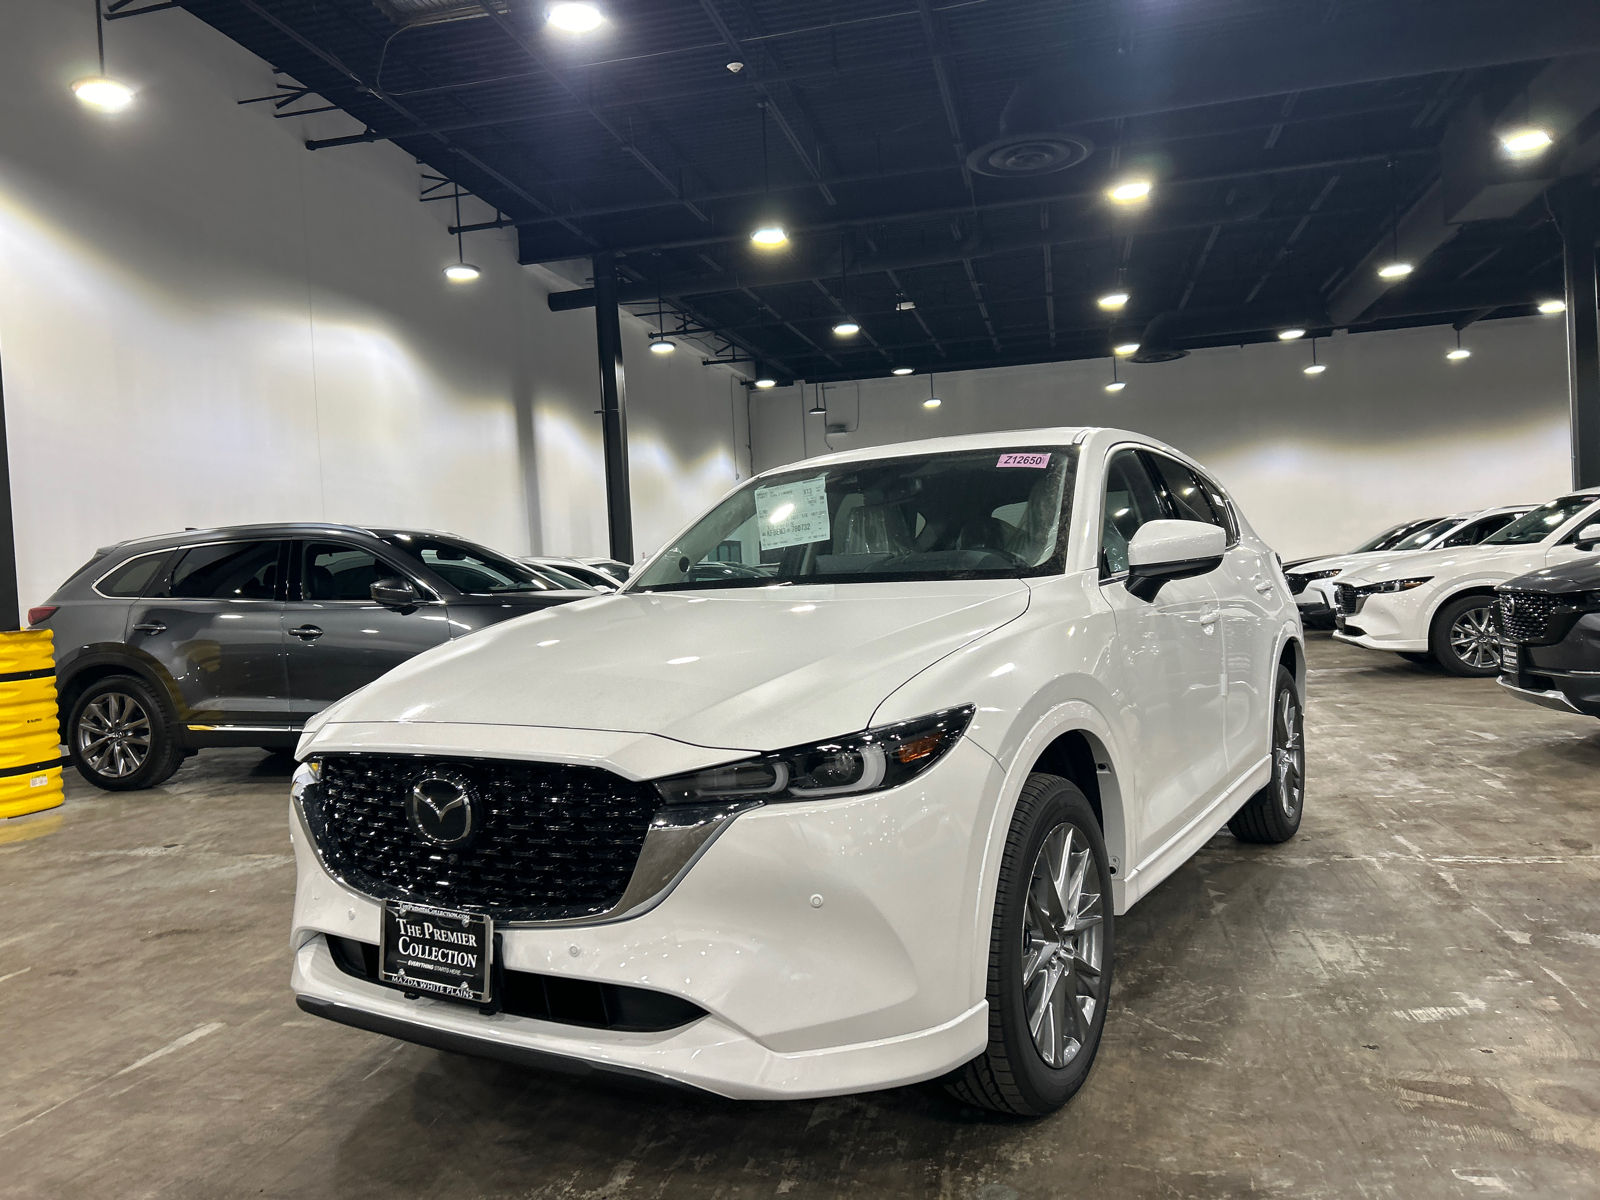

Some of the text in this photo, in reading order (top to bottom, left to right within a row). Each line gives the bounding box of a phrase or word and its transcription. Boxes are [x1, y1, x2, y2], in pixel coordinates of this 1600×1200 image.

[1004, 455, 1042, 465] Z12650
[423, 922, 477, 947] PREMIER
[398, 936, 478, 968] COLLECTION
[407, 960, 434, 970] EVERYTHING
[391, 975, 474, 999] MAZDA WHITE PLAINS
